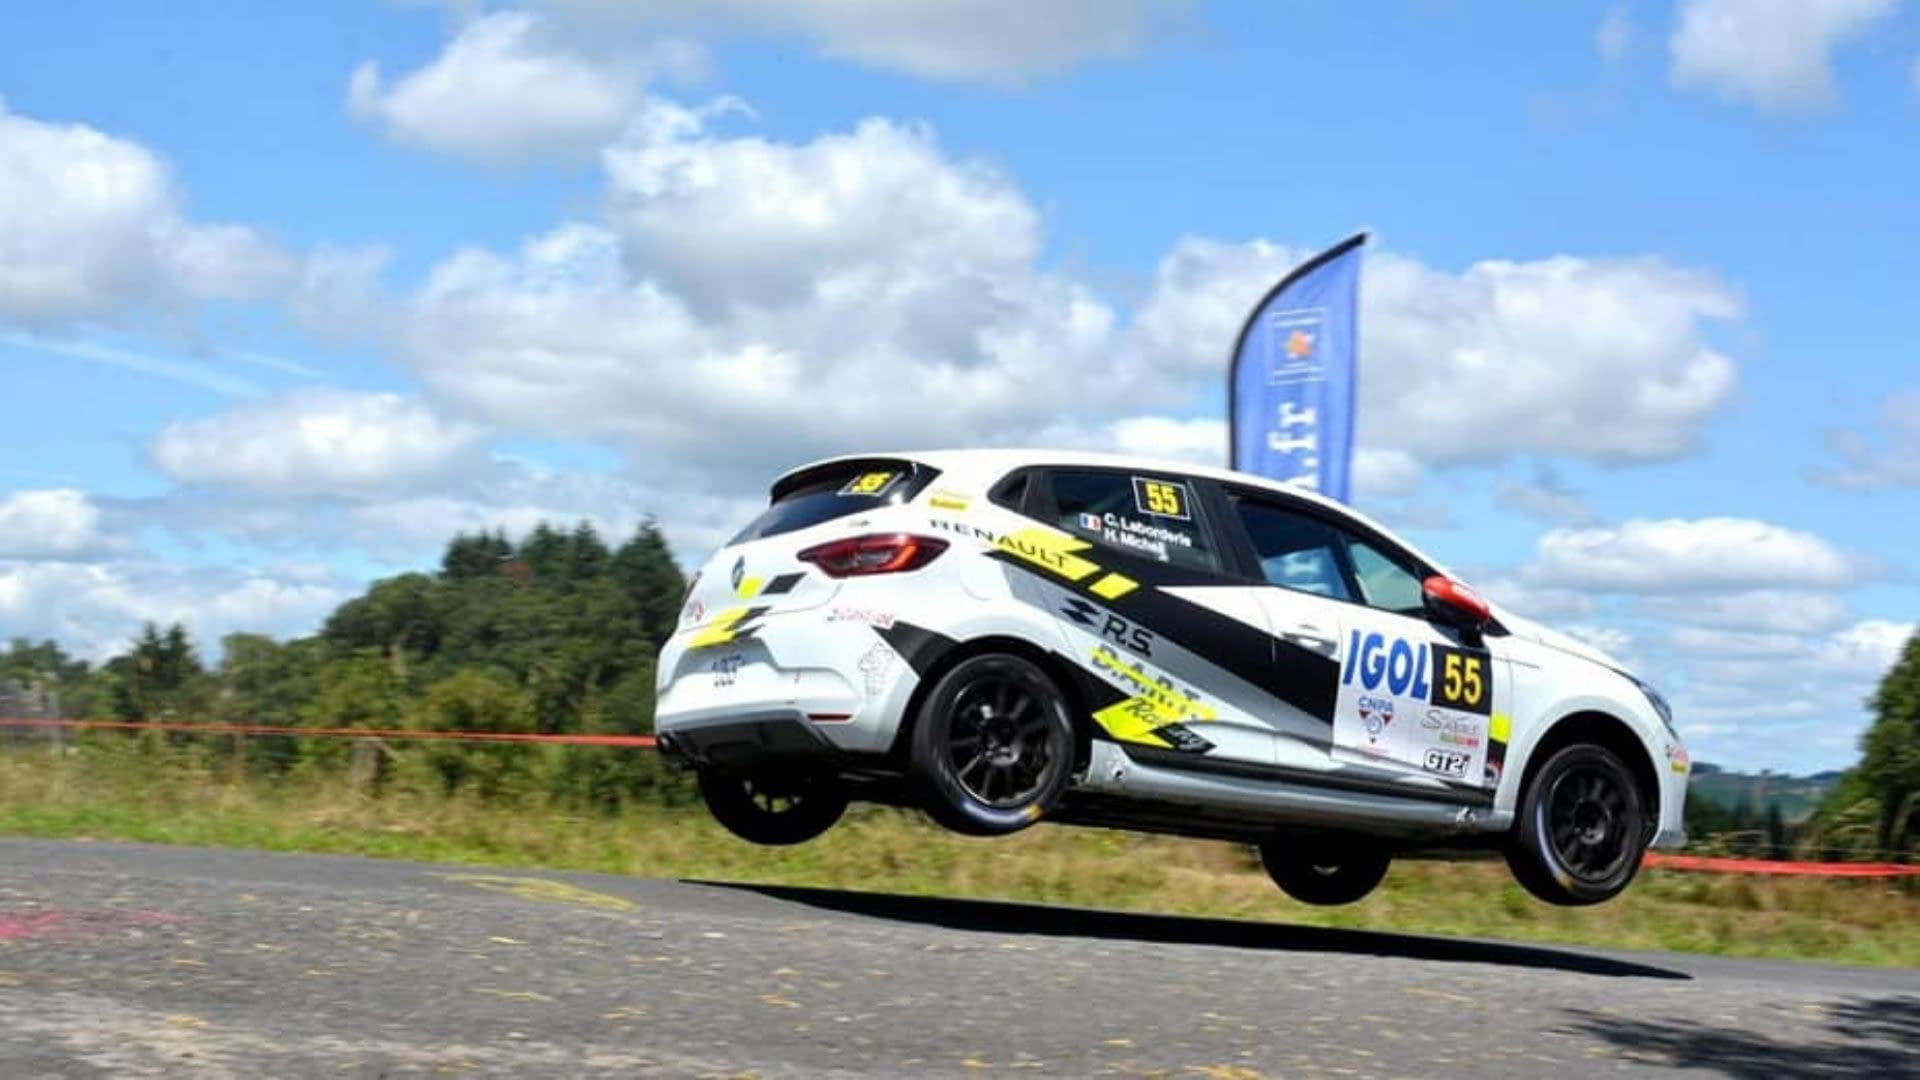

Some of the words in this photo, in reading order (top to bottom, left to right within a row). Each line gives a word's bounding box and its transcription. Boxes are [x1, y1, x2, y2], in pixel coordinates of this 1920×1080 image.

[1104, 512, 1119, 527] C.
[1145, 483, 1179, 514] 55
[930, 519, 1068, 568] RENAULT
[1343, 629, 1431, 701] IGOL
[1444, 654, 1482, 706] 55
